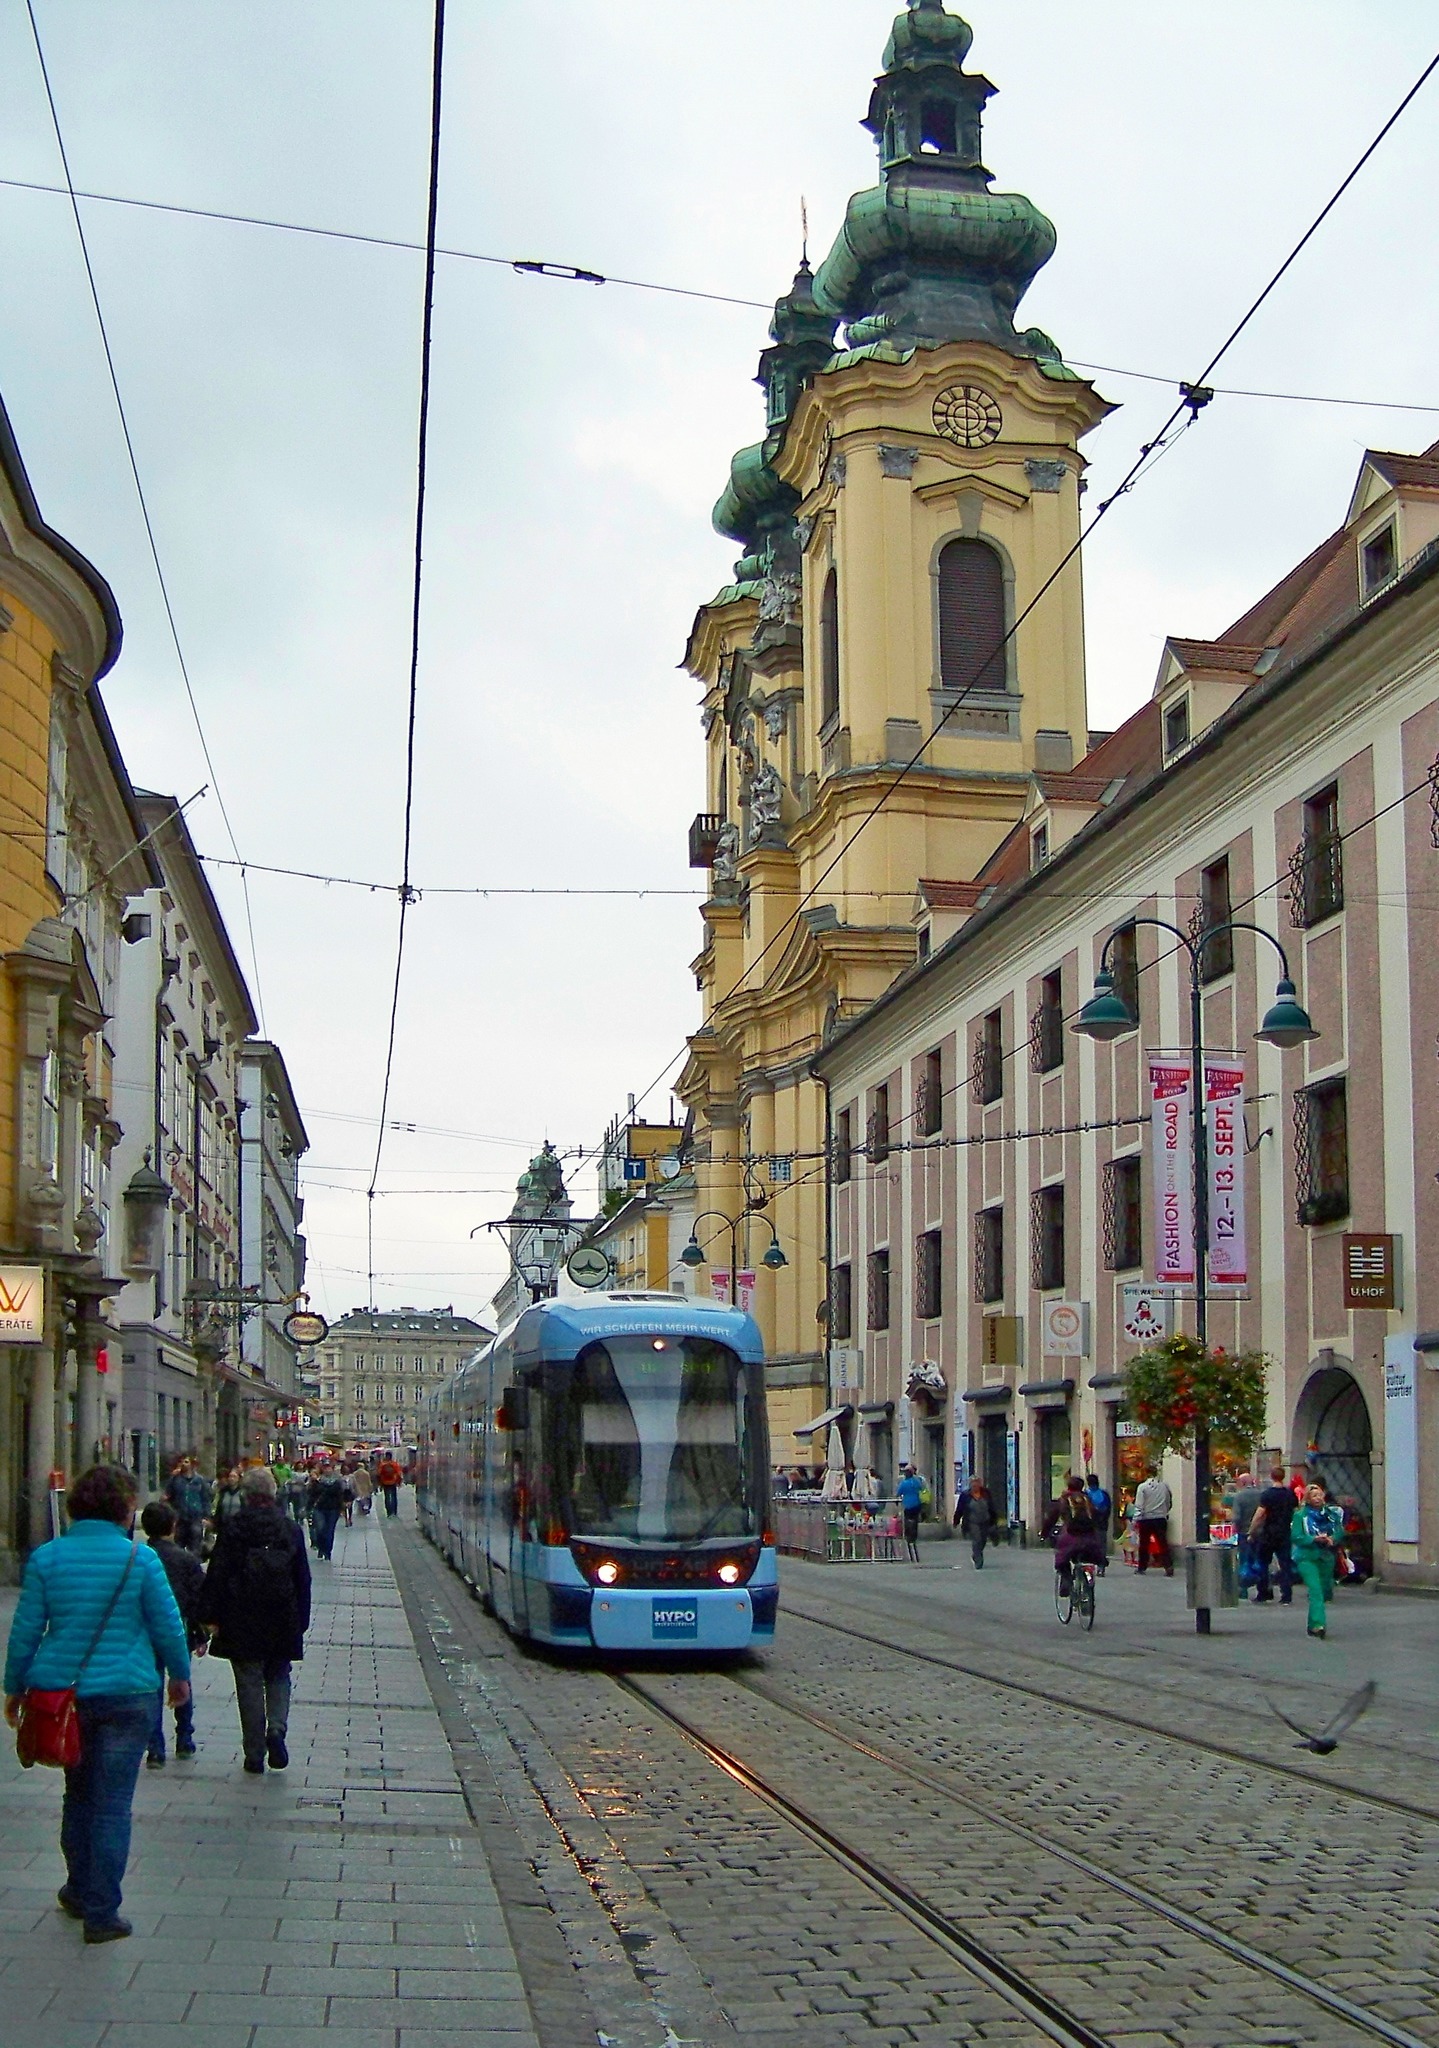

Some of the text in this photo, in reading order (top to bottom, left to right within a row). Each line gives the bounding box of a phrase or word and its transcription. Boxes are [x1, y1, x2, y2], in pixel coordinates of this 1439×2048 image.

[1215, 1102, 1234, 1156] SEPT.
[628, 1162, 641, 1178] T
[1164, 1102, 1180, 1269] FASHION ON THE ROAD
[580, 1325, 601, 1336] WIR
[604, 1323, 663, 1333] SCHAFFEN
[665, 1323, 697, 1333] MEHR
[654, 1610, 696, 1622] HYPO
